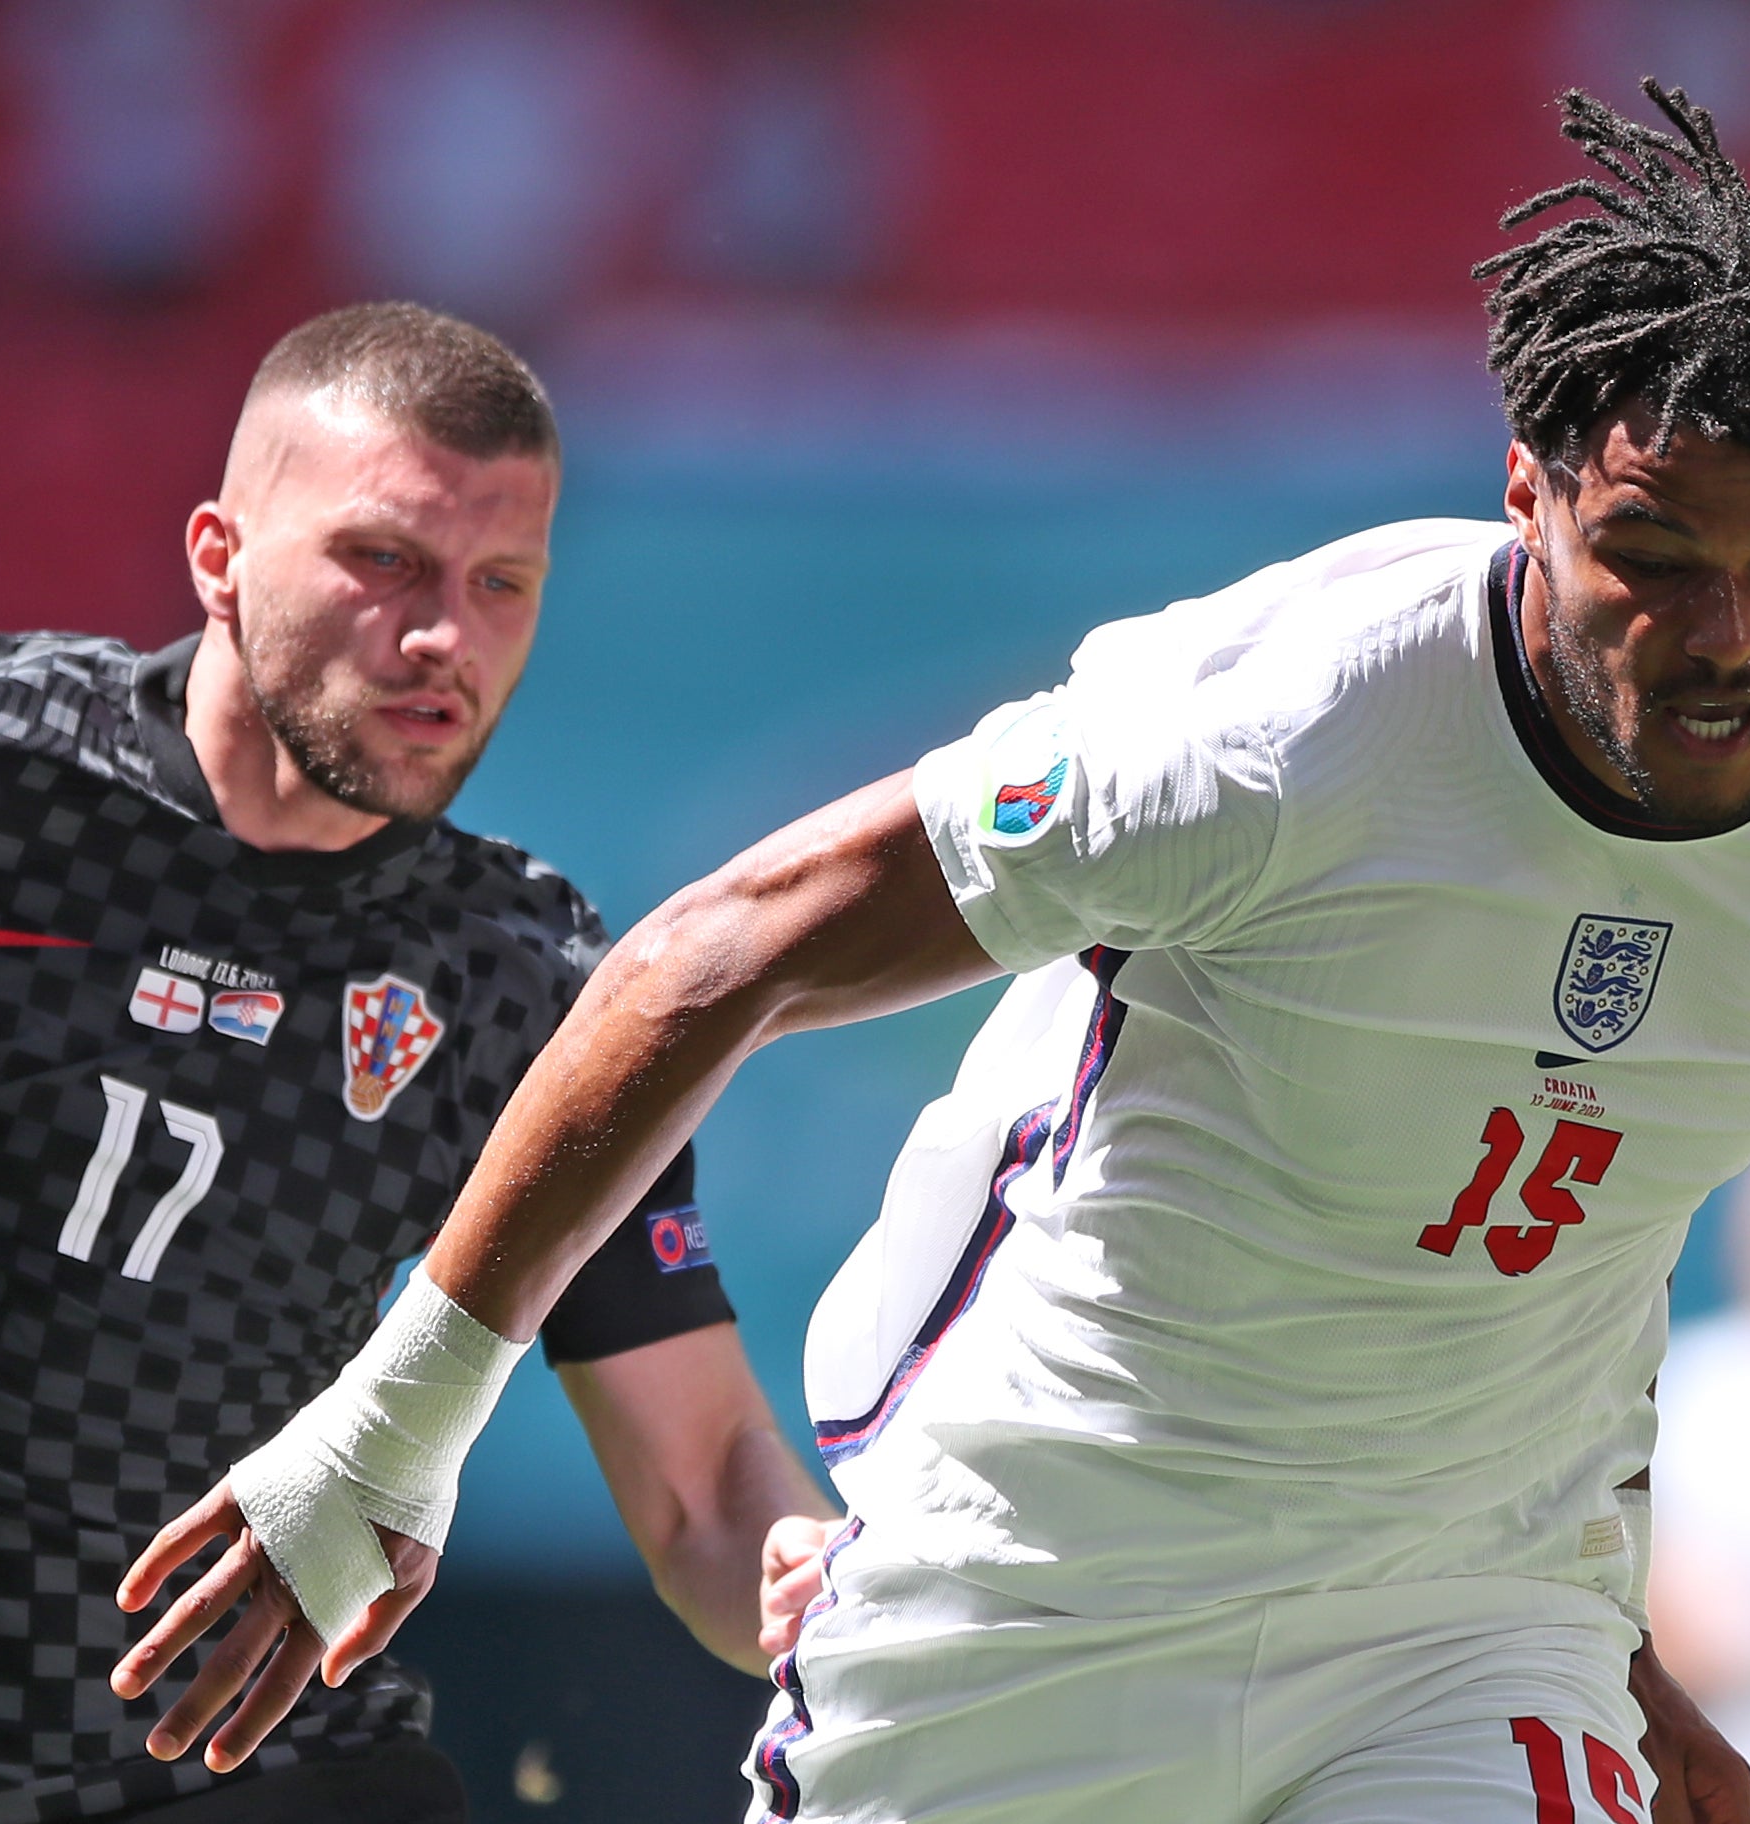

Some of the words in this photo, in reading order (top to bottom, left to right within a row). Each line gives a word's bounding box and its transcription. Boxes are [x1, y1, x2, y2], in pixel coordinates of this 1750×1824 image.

[1544, 1077, 1597, 1102] CROATIA
[1544, 1098, 1579, 1113] JUNE
[1577, 1103, 1606, 1119] 2021
[57, 1073, 225, 1283] 17
[1416, 1105, 1624, 1277] 15
